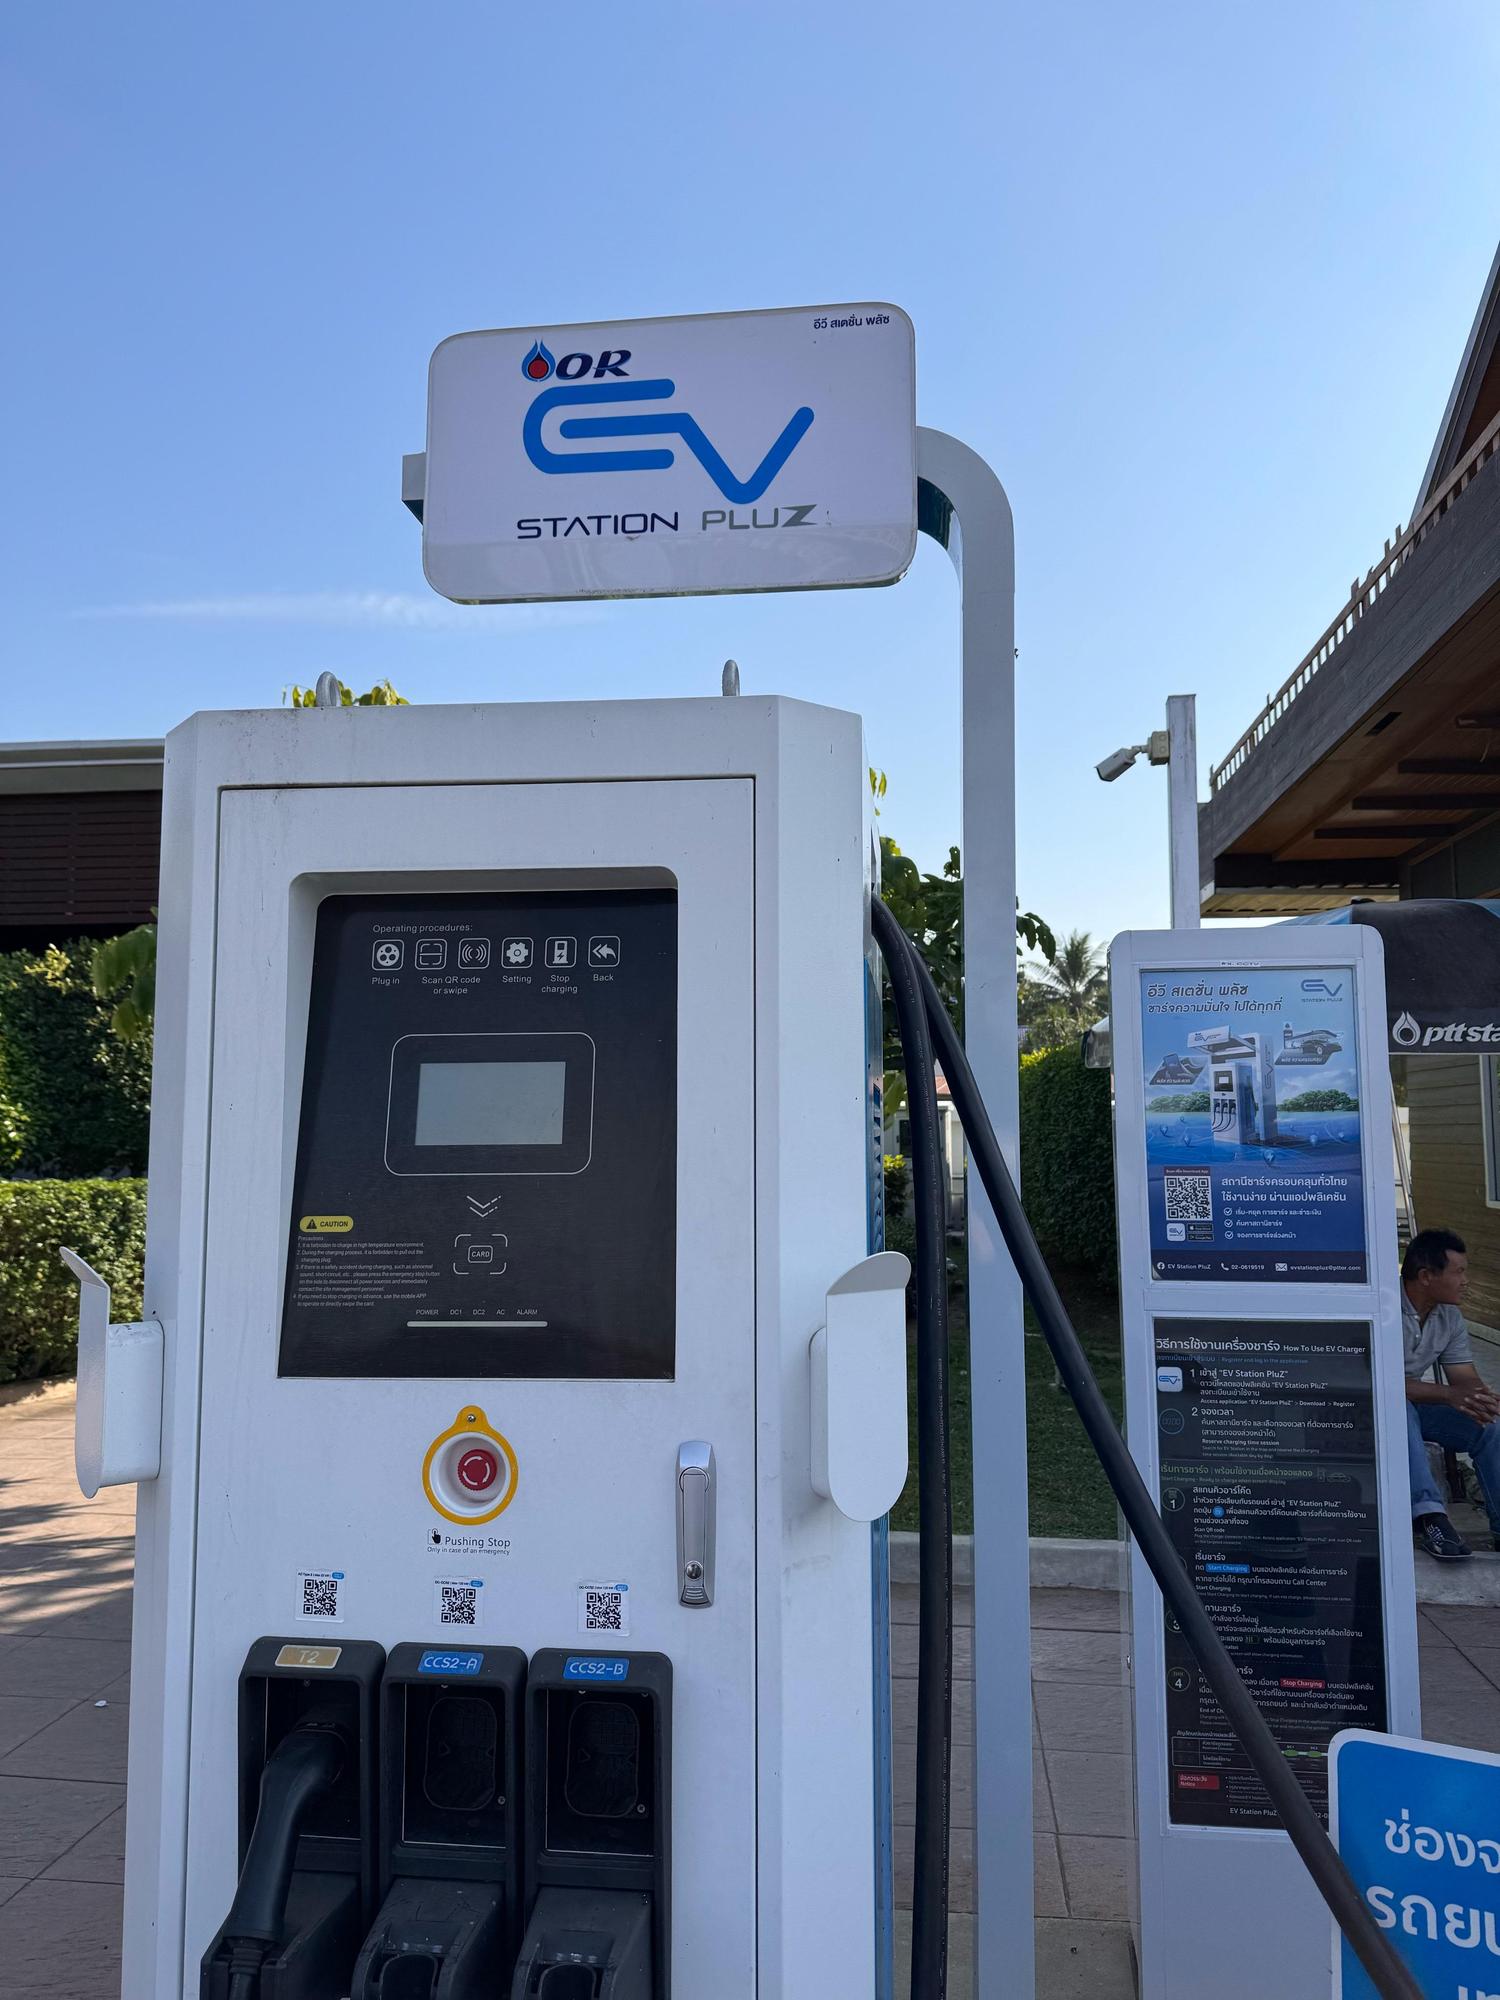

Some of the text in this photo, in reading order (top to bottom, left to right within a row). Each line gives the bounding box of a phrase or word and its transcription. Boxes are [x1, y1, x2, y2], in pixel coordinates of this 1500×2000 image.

[813, 317, 828, 329] อีวี
[555, 348, 632, 380] OR
[522, 378, 815, 505] EV
[516, 504, 818, 540] STATION PLUZ
[372, 924, 473, 934] Operating procedures:
[371, 977, 400, 986] Plug in
[422, 976, 481, 985] Scan QR code
[502, 974, 532, 985] Setting
[550, 974, 570, 984] Stop
[593, 973, 614, 982] Back
[443, 986, 468, 997] swipe
[541, 984, 578, 994] charging
[1147, 984, 1166, 998] อีวี
[1171, 980, 1214, 998] สเตชั่น
[1301, 979, 1343, 997] EV
[1283, 1344, 1299, 1352] How
[1311, 1345, 1325, 1353] Use
[1326, 1345, 1336, 1353] EV
[1337, 1345, 1366, 1355] Charger
[1235, 1369, 1265, 1378] Station
[1285, 1381, 1309, 1390] Station
[1191, 1406, 1199, 1416] 2
[1170, 1499, 1176, 1509] 1
[1299, 1499, 1323, 1508] Station
[445, 1536, 511, 1549] Pushing Stop
[427, 1546, 441, 1554] Only
[1222, 1564, 1248, 1573] Charging
[1292, 1578, 1305, 1586] Call
[1305, 1579, 1328, 1587] Center
[1204, 1603, 1242, 1613] ถานะชาร์จ
[299, 1650, 319, 1664] T2
[424, 1655, 478, 1675] CCS2-A
[569, 1661, 624, 1675] CCS2-B
[1174, 1678, 1183, 1689] 4
[1282, 1679, 1296, 1687] Stop
[1297, 1679, 1323, 1689] Charging
[1239, 1807, 1262, 1816] Station
